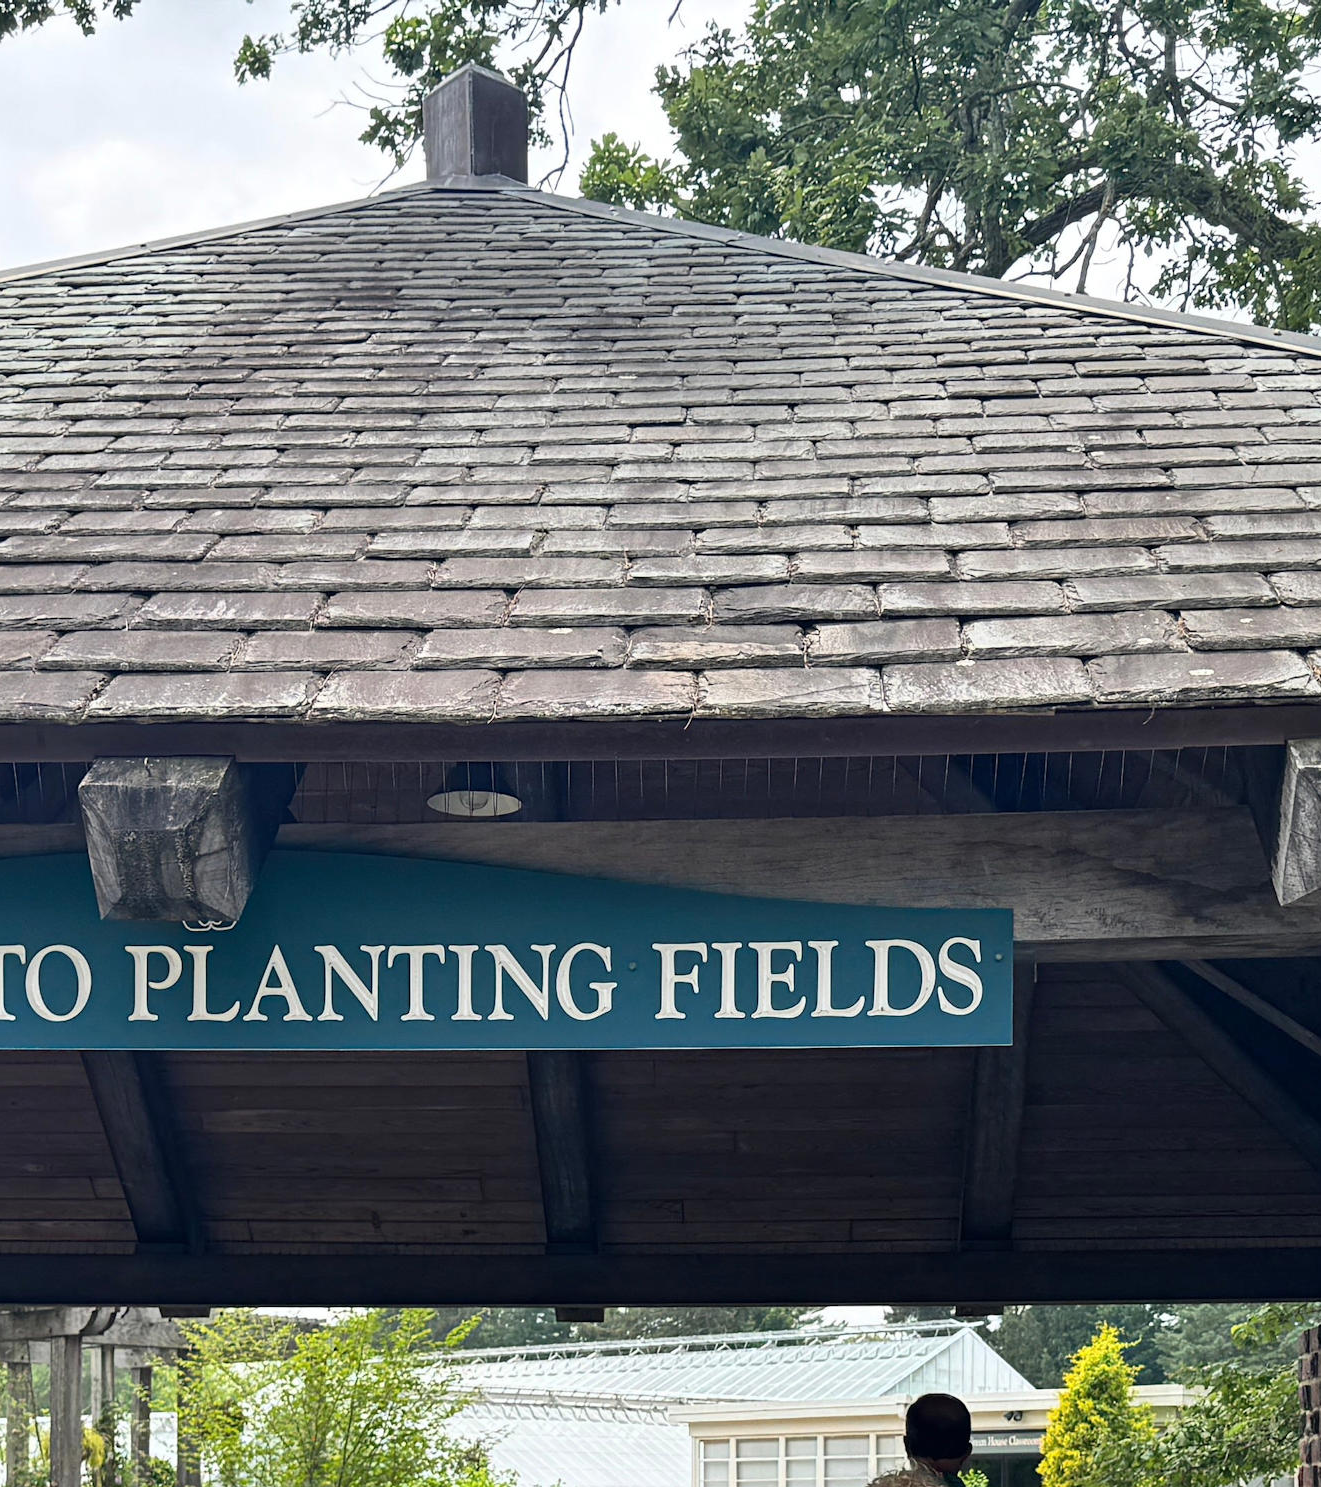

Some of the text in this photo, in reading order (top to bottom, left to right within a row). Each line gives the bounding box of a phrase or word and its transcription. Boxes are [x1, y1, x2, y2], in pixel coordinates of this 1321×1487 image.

[125, 941, 619, 1023] PLANTING
[652, 936, 984, 1020] FIELDS
[988, 1436, 1008, 1446] House
